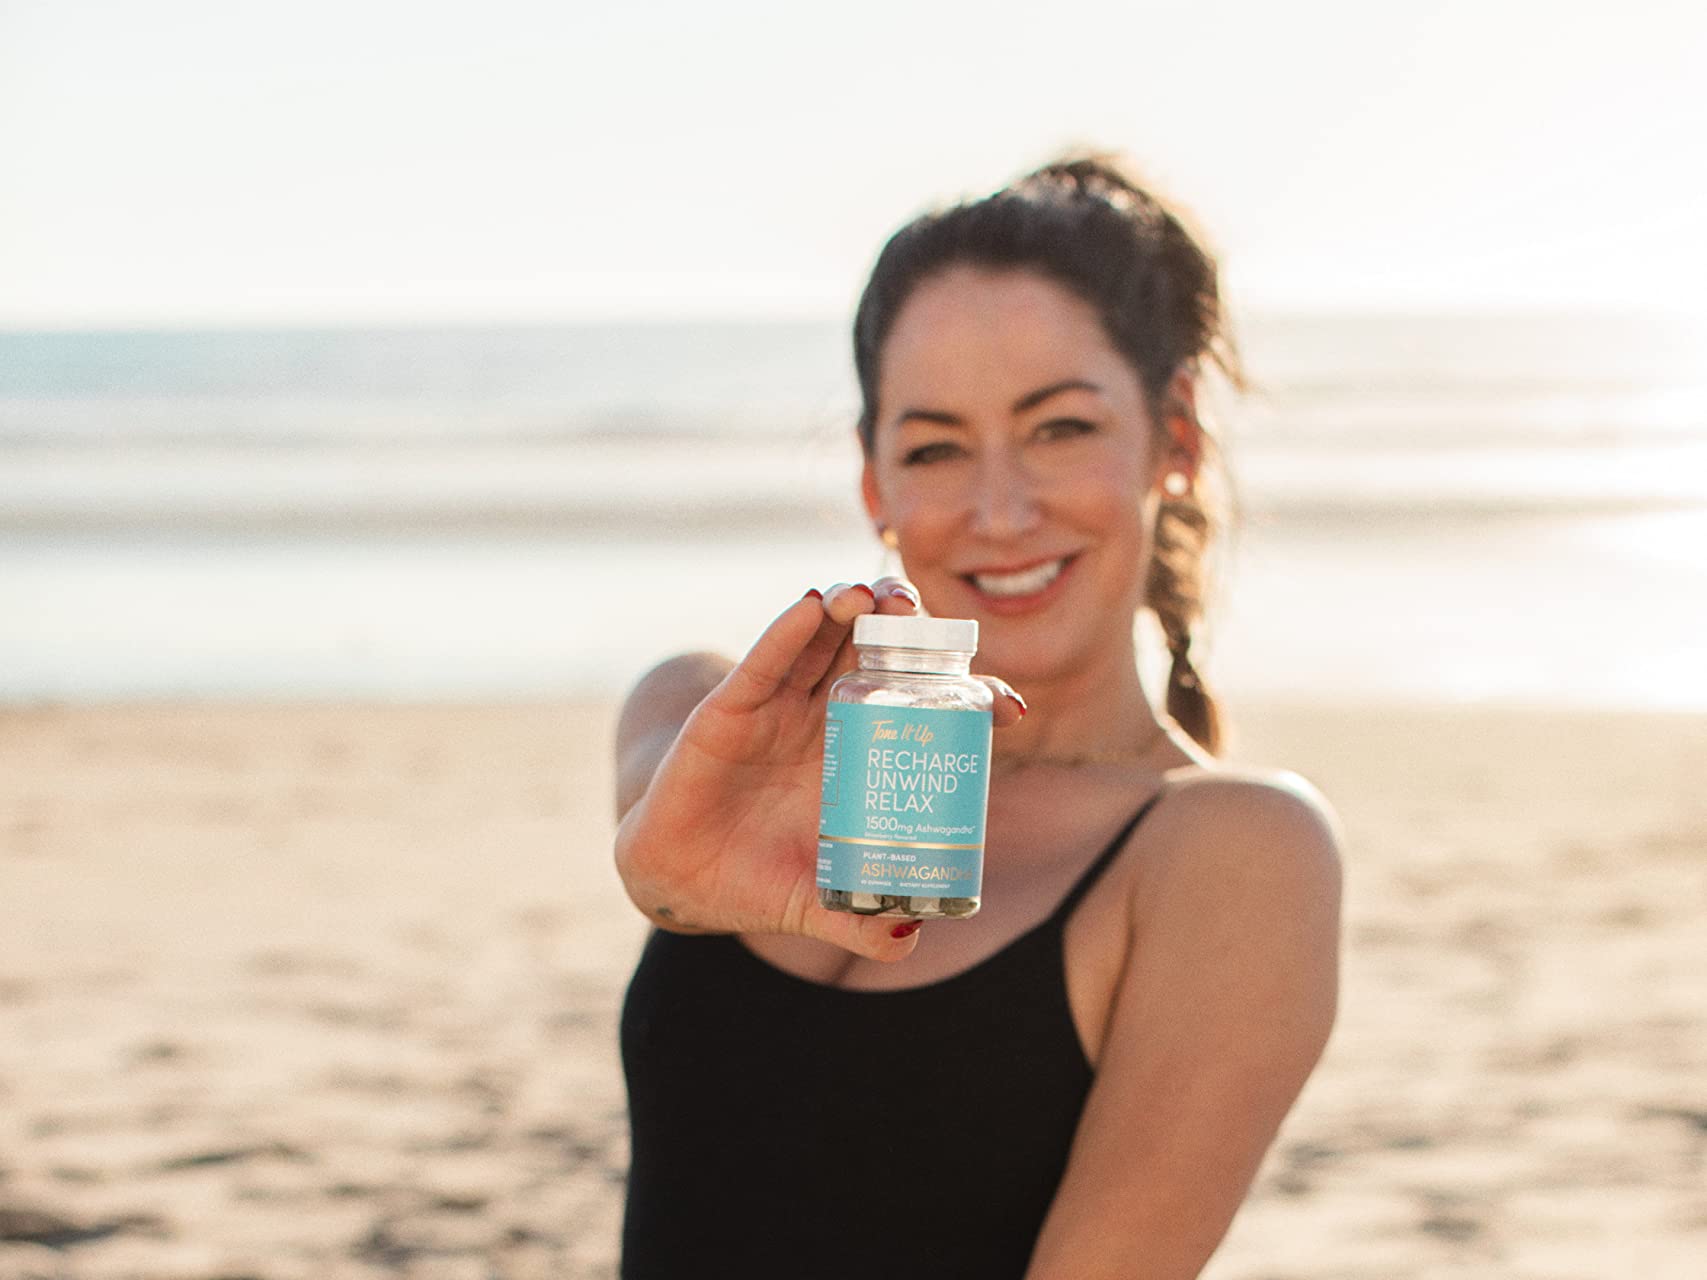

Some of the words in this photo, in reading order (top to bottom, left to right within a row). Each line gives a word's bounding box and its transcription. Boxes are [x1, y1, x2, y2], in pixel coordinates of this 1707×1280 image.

[871, 720, 898, 743] Tone
[900, 723, 914, 741] It
[914, 724, 934, 748] Up
[867, 748, 978, 773] RECHARGE
[866, 769, 958, 793] UNWIND
[865, 790, 934, 813] RELAX
[865, 815, 913, 835] 1500mg
[863, 851, 917, 862] PLANT-BASED
